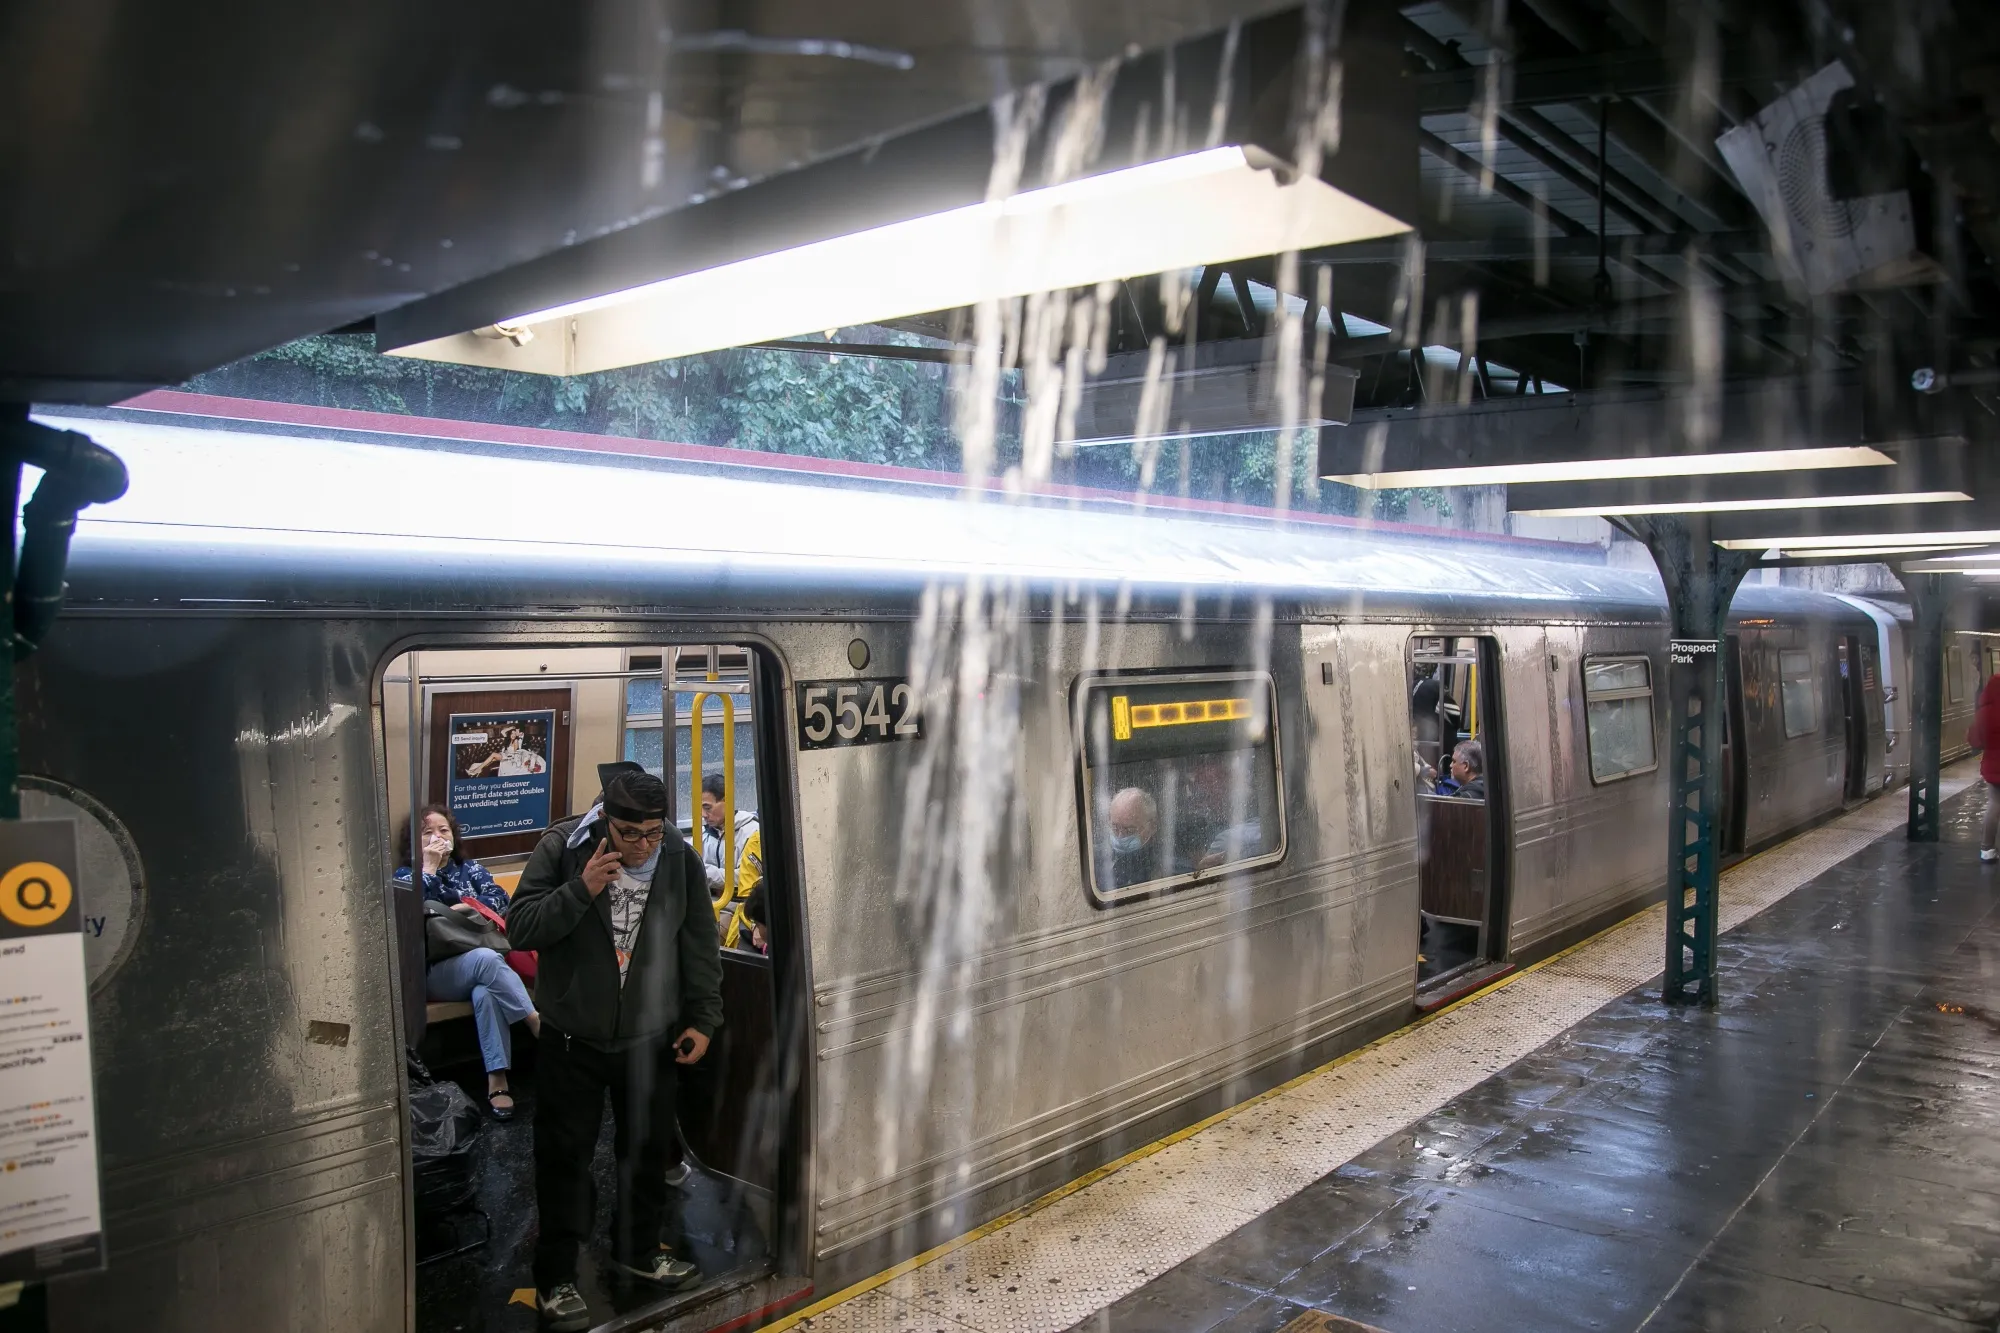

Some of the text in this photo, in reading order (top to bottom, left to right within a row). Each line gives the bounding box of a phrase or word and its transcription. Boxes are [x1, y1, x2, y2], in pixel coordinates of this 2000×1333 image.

[1671, 643, 1717, 654] Prospect
[1671, 654, 1694, 664] Park
[804, 683, 919, 742] 5542
[454, 794, 471, 802] your
[503, 789, 519, 798] spot
[519, 787, 545, 795] doubles
[469, 799, 499, 808] wedding
[503, 819, 523, 828] ZOLA
[16, 876, 57, 911] Q
